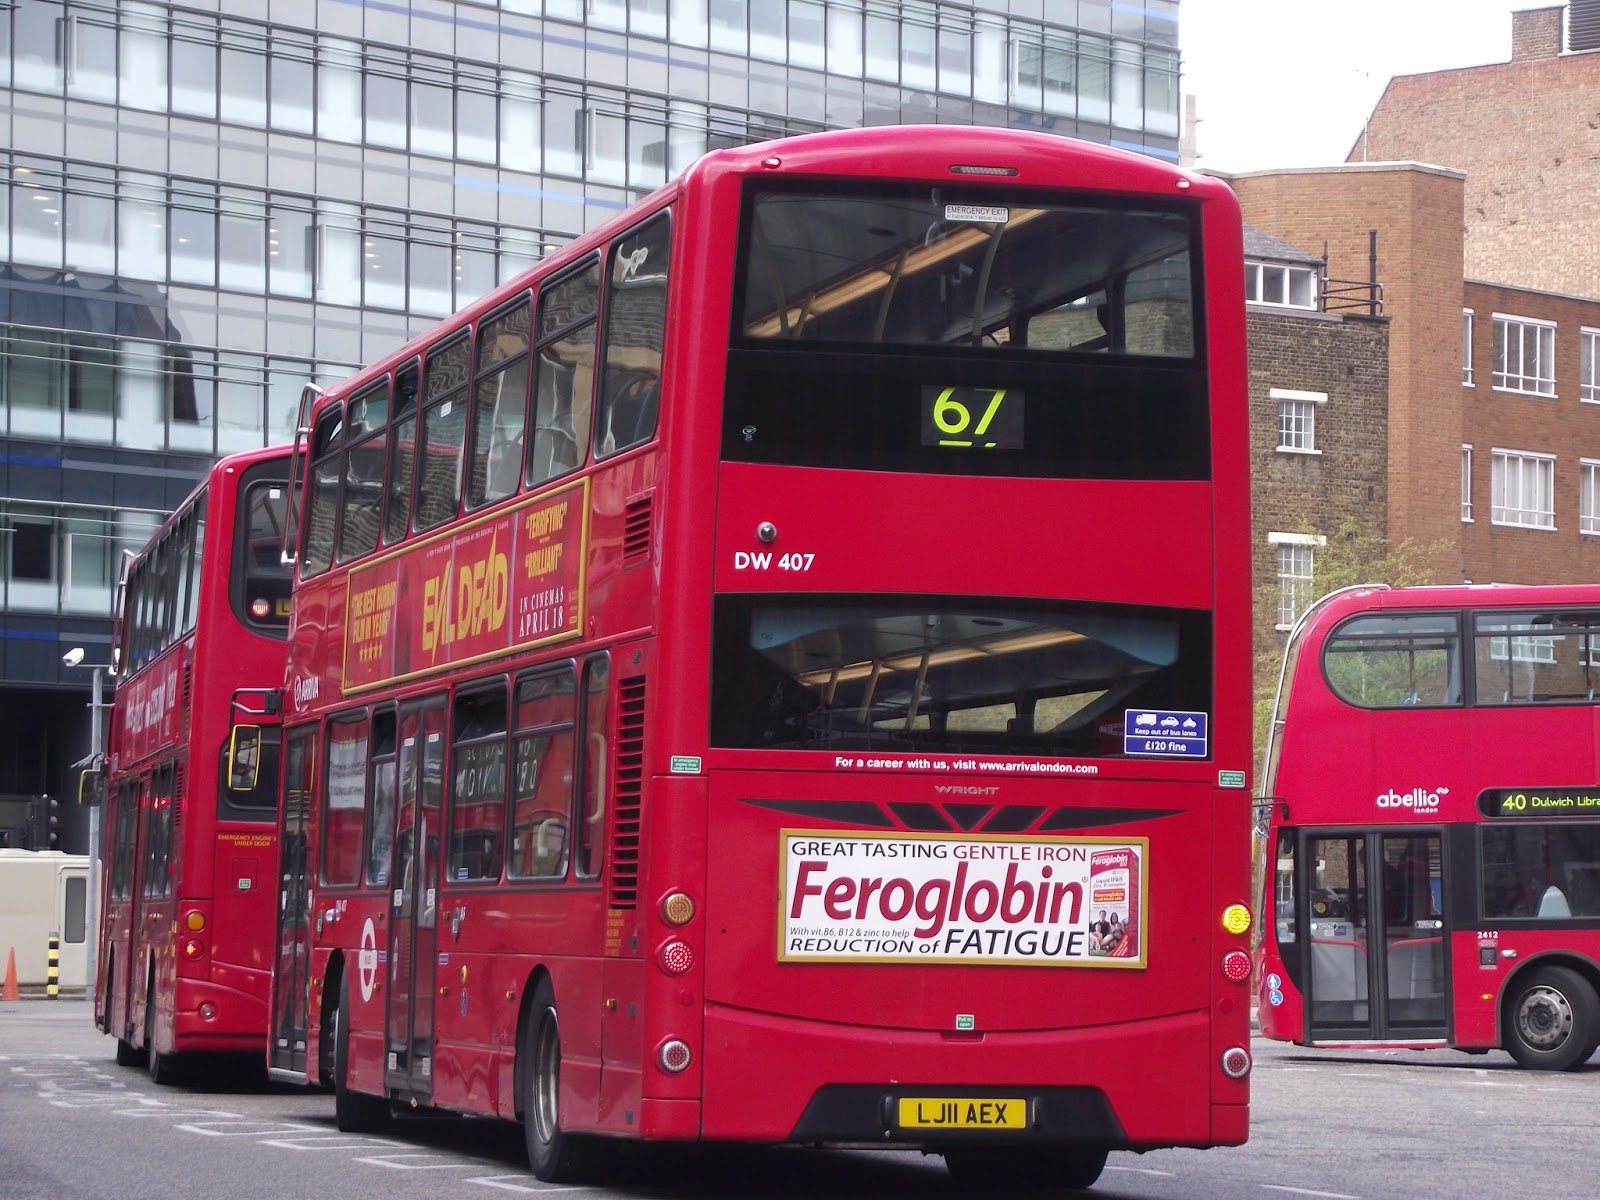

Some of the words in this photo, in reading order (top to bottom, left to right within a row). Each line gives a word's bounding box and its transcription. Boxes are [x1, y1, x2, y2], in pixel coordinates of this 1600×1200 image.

[947, 206, 990, 215] EMERGENCY
[992, 208, 1006, 216] EXIT
[934, 386, 1007, 434] 67
[735, 552, 772, 570] DW
[778, 553, 815, 571] 407
[457, 526, 508, 640] DEAD
[520, 596, 529, 613] IN
[532, 586, 564, 610] CINEMAS
[519, 608, 550, 637] APRIL
[553, 605, 564, 628] 18
[1134, 728, 1150, 736] Keep
[1145, 740, 1166, 750] £120
[1168, 742, 1186, 752] fine
[836, 756, 854, 767] For
[856, 759, 864, 767] a
[866, 759, 904, 768] career
[907, 758, 930, 769] with
[934, 761, 950, 771] us,
[953, 760, 976, 770] visit
[979, 761, 1098, 774] www.arrivalondon.com
[934, 786, 999, 795] WRIGHT
[1376, 788, 1440, 807] abellio
[1502, 794, 1526, 810] 40
[1532, 796, 1574, 807] Dulwich
[792, 842, 858, 858] GREAT
[861, 842, 948, 858] TASTING
[952, 845, 1032, 861] GENTLE
[1037, 847, 1087, 862] IRON
[1092, 854, 1128, 866] Feroglobin
[790, 860, 1084, 939] Feroglobin
[790, 926, 810, 936] With
[838, 928, 854, 938] B12
[856, 928, 862, 937] &
[864, 928, 880, 938] zinc
[892, 928, 910, 938] help
[1478, 930, 1498, 938] 2412
[790, 938, 914, 953] REDUCTION
[919, 940, 942, 954] of
[944, 928, 1085, 956] FATIGUE
[966, 1103, 1008, 1124] AEX
